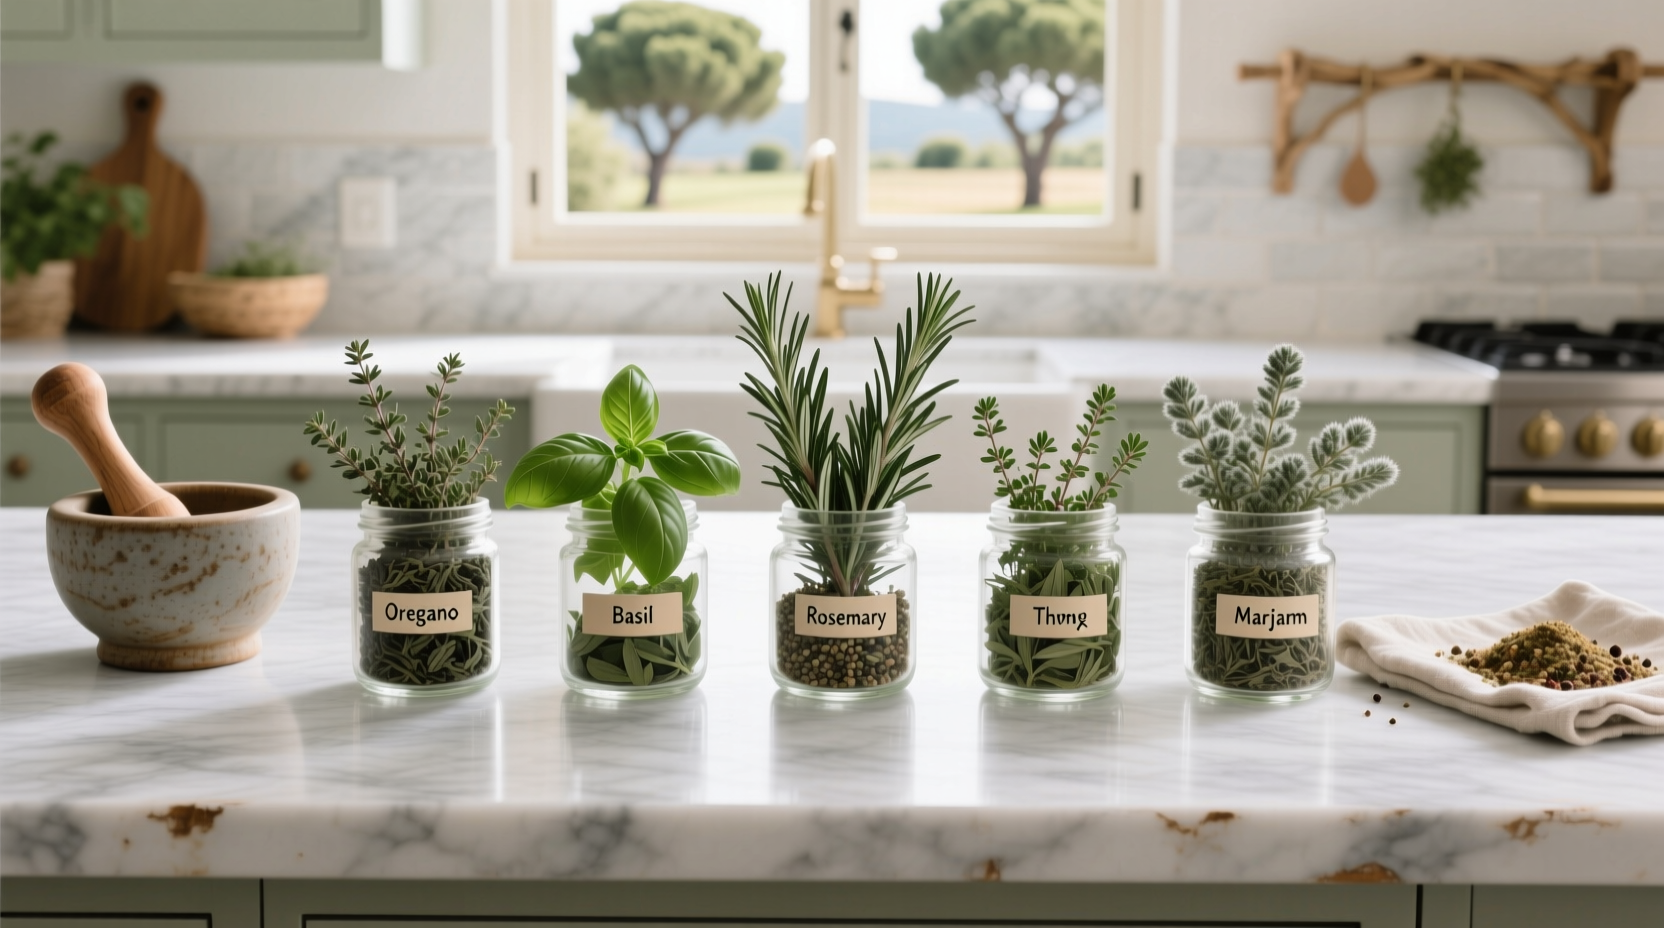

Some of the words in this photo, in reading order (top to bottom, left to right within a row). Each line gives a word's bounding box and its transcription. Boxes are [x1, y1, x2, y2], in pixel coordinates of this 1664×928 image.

[385, 602, 459, 628] Oregano
[612, 605, 653, 625] Basil
[807, 605, 887, 631] Rosemary
